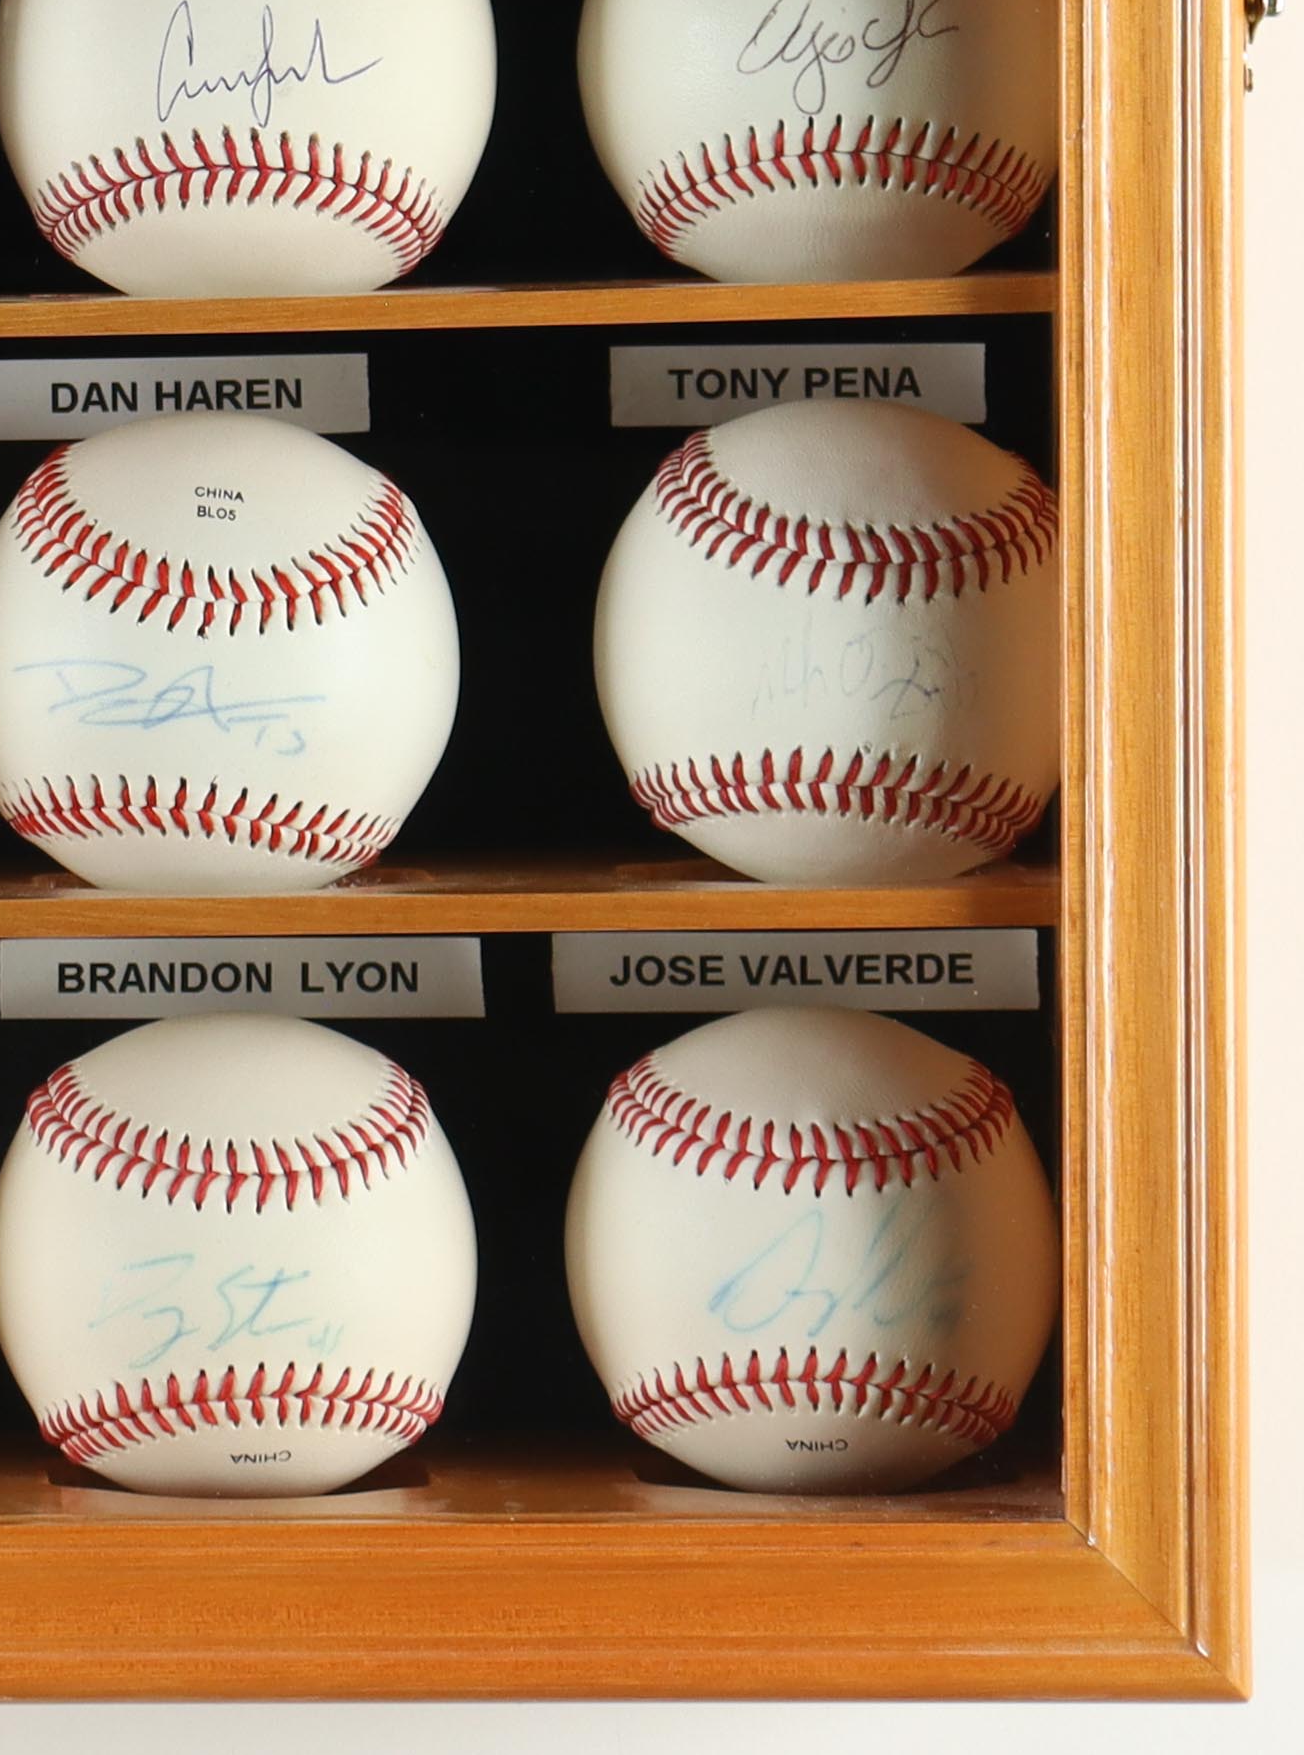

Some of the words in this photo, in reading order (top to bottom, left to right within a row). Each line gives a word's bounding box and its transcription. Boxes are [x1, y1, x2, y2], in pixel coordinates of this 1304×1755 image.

[51, 381, 138, 414] DAN
[155, 378, 302, 411] HAREN
[667, 367, 789, 400] TONY
[804, 366, 922, 399] PENA
[194, 486, 245, 503] CHINA
[58, 962, 272, 994] BRANDON
[301, 961, 418, 993] LYON
[609, 955, 726, 987] JOSE
[739, 953, 974, 986] VALVERDE
[230, 1450, 292, 1464] CHINA
[785, 1438, 849, 1452] CHINA
